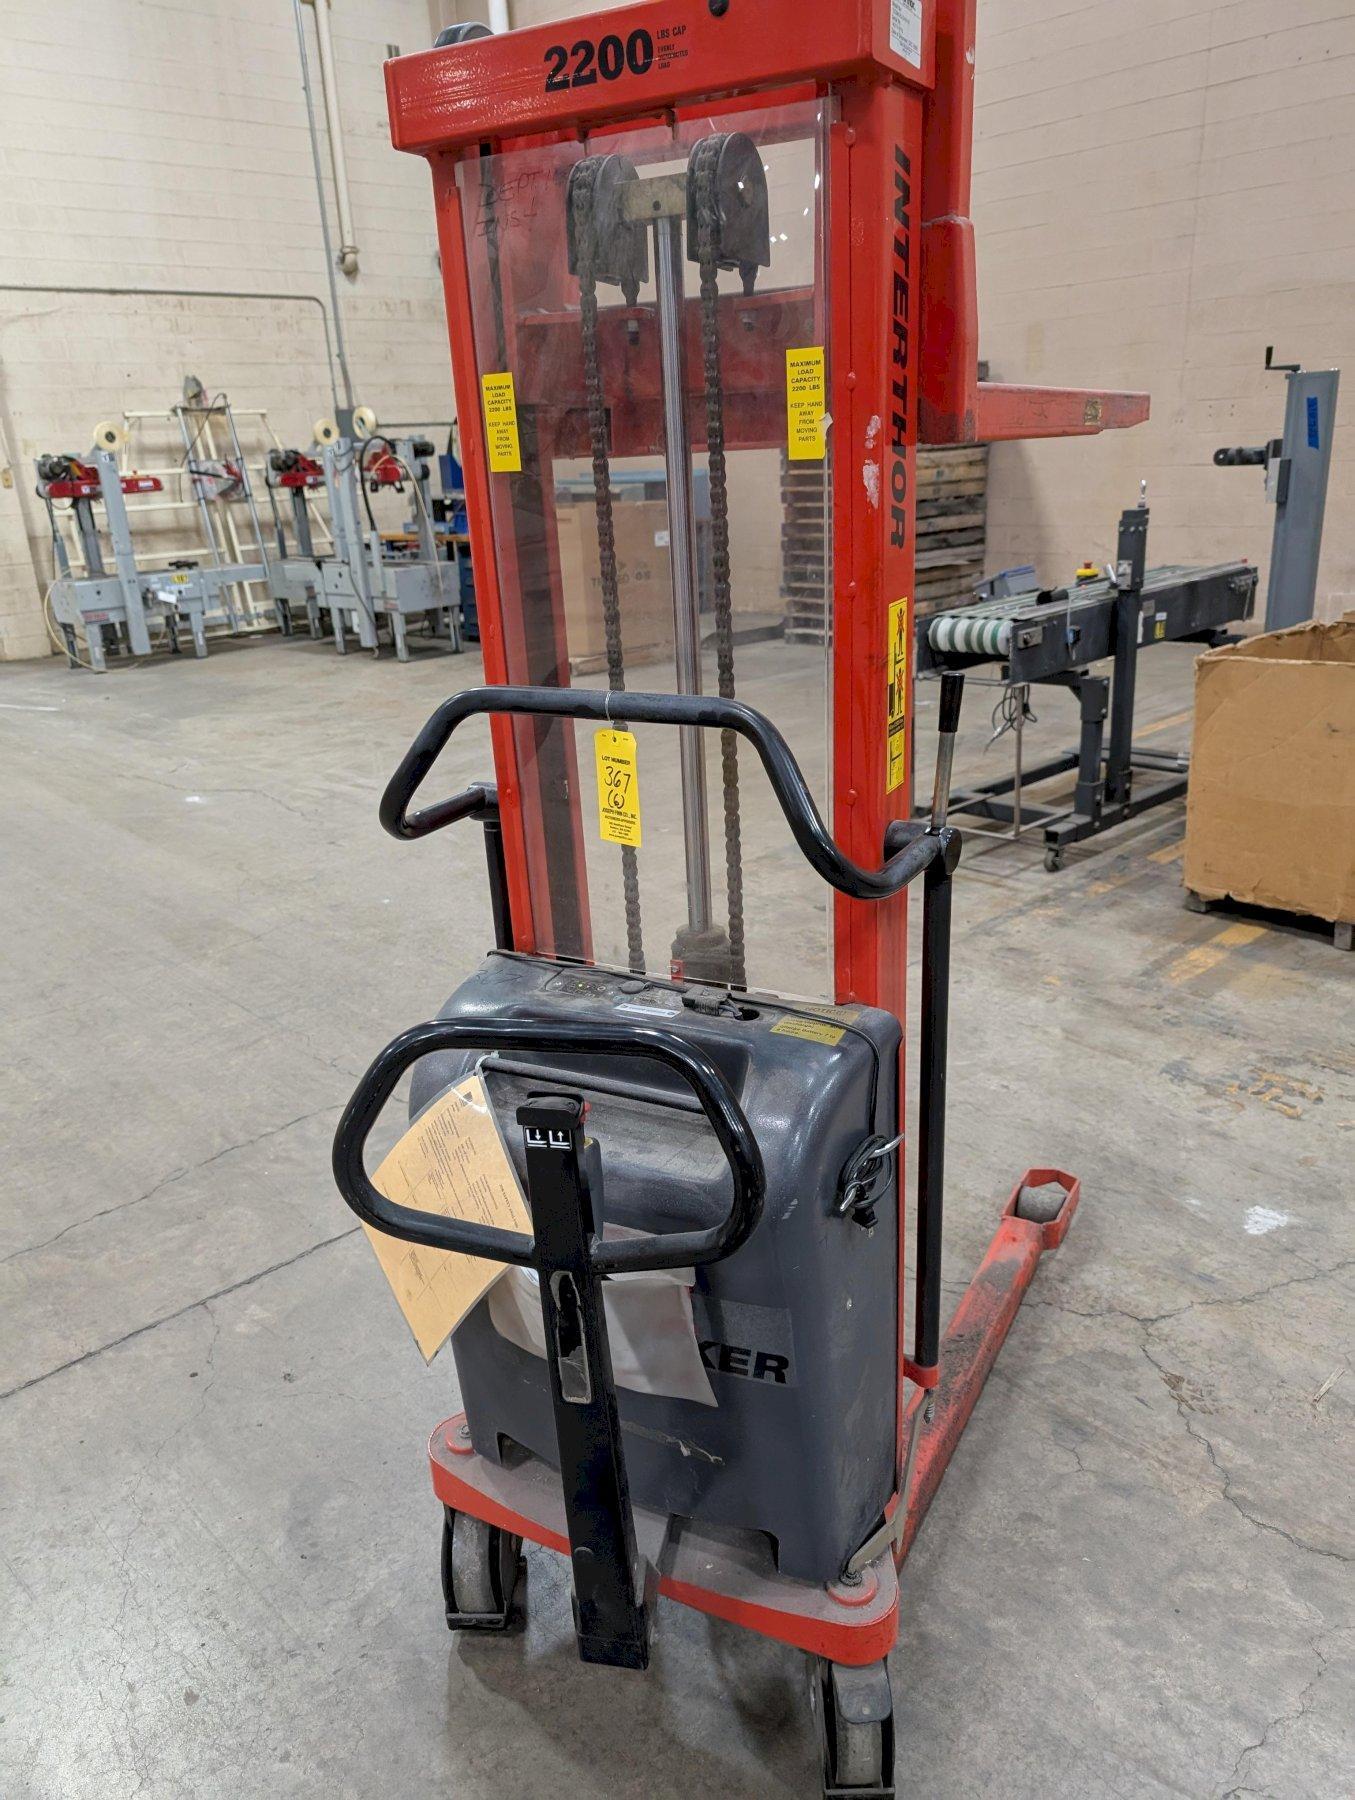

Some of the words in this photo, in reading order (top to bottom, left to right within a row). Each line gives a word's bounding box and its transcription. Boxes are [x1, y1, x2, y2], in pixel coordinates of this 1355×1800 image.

[544, 28, 654, 92] 2200
[656, 29, 670, 39] LBS
[672, 25, 687, 36] CAP
[891, 143, 911, 549] INTERTHOR
[790, 360, 821, 368] MAXIMUM
[791, 376, 821, 384] CAPACITY
[611, 757, 631, 766] NUMBER
[604, 765, 631, 794] 367
[608, 789, 625, 809] (6)
